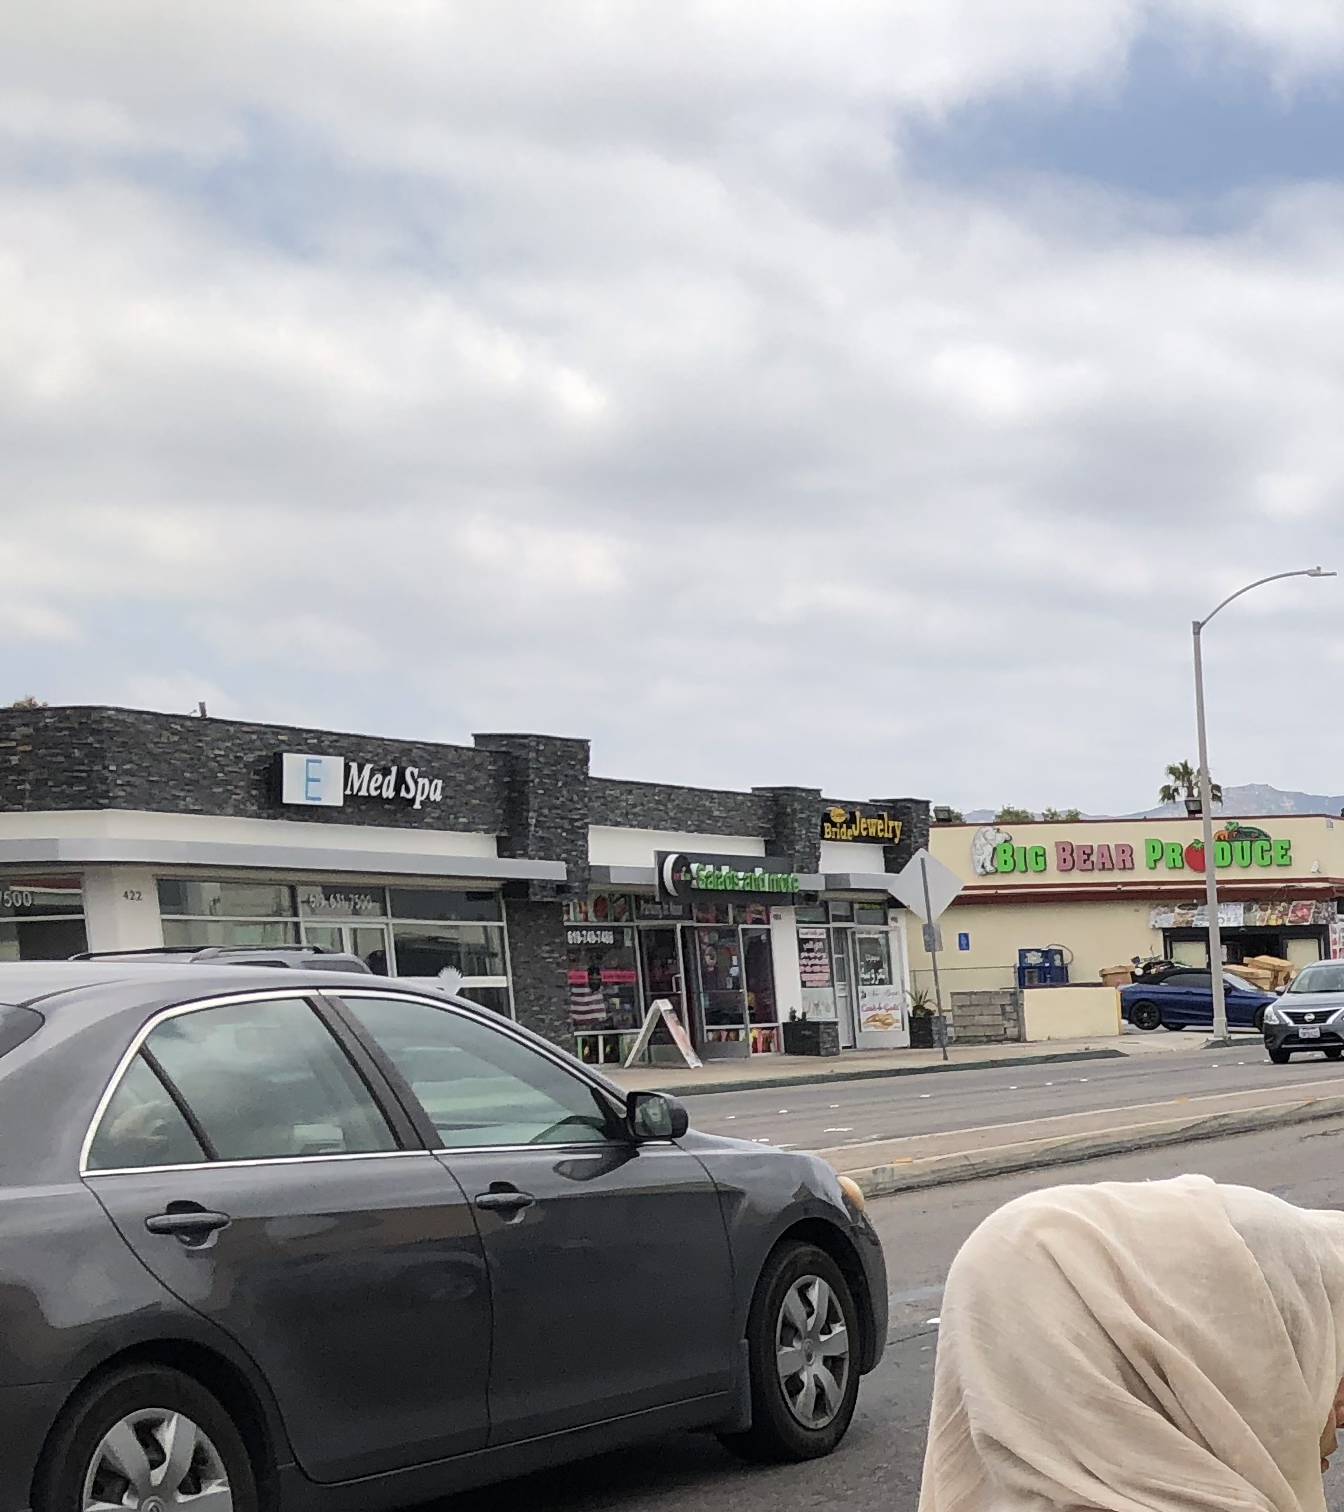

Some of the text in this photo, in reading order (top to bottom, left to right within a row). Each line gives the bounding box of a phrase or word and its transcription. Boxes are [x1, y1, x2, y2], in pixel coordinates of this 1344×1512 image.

[345, 761, 397, 800] Med
[400, 766, 444, 809] Spa
[823, 810, 903, 844] Bride Jewelry
[995, 840, 1047, 873] BIG
[1054, 840, 1135, 873] BEAR
[0, 889, 32, 908] 500
